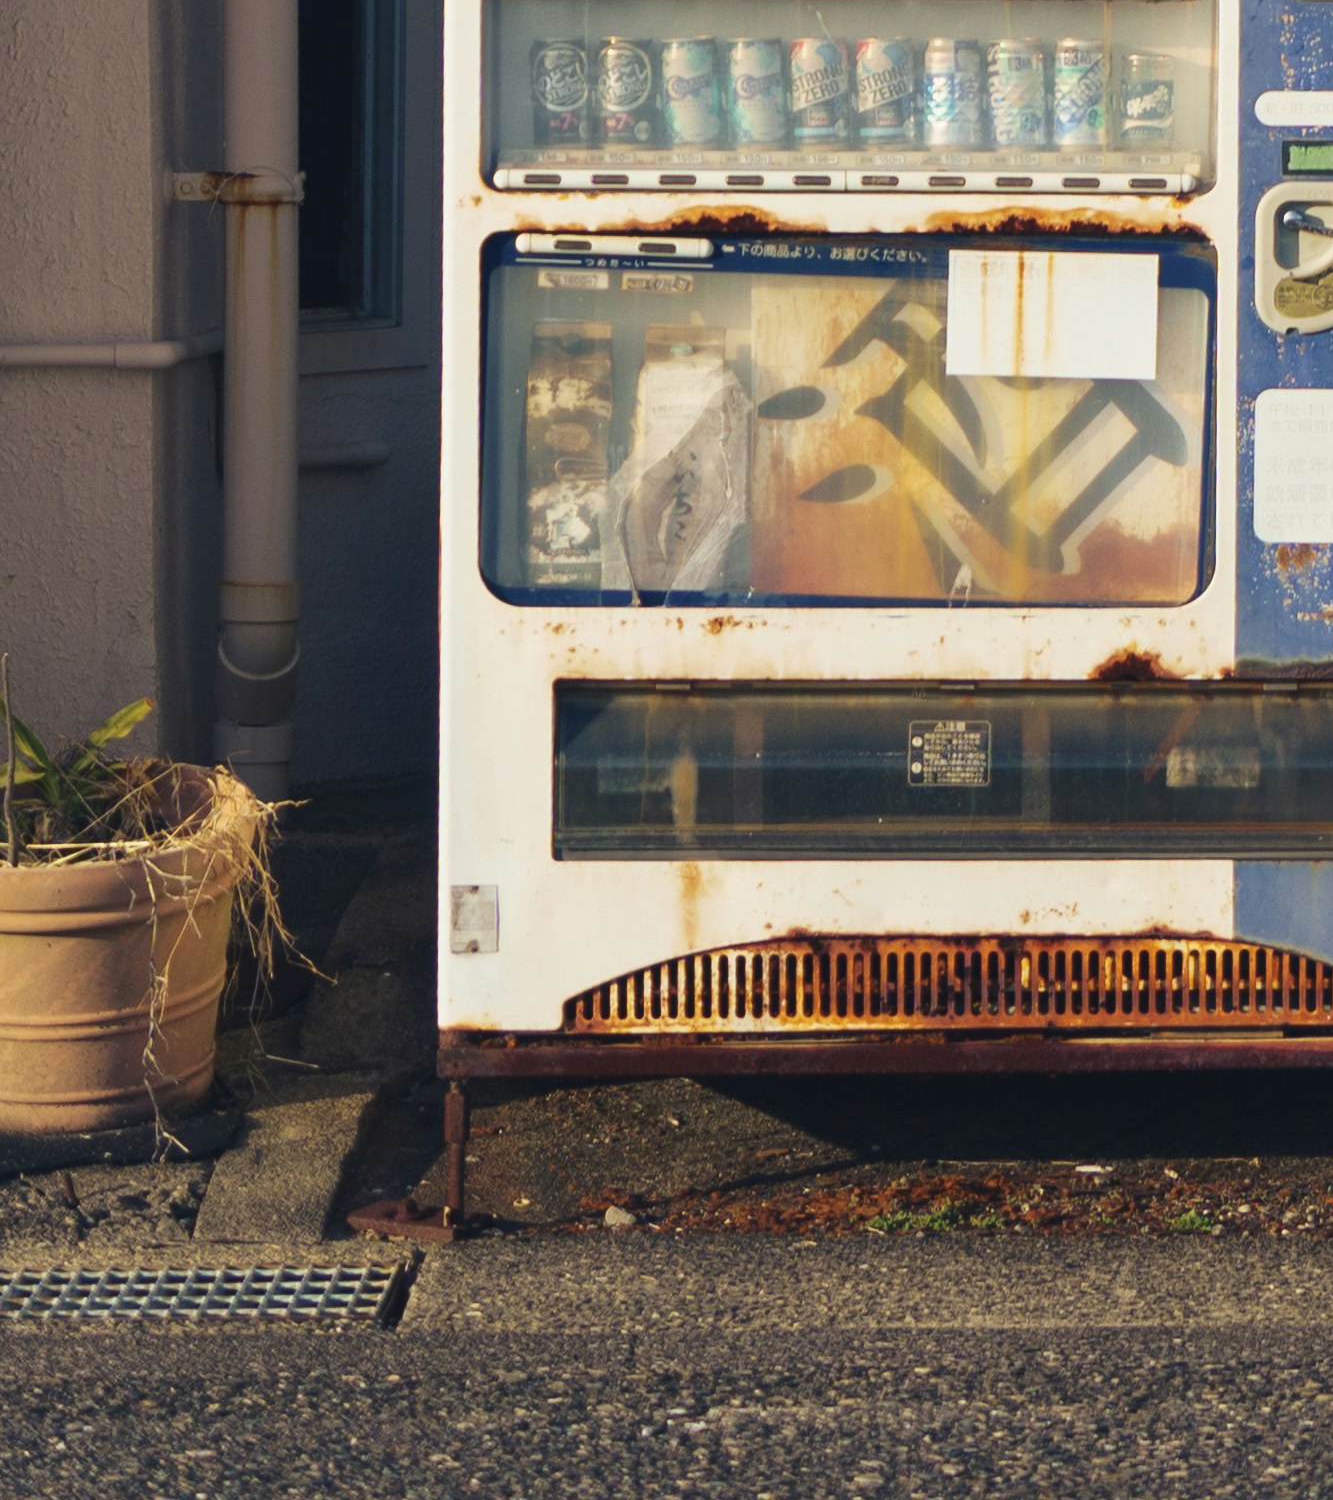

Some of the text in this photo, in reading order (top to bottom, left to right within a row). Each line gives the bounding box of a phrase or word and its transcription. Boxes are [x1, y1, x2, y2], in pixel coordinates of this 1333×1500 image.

[804, 80, 839, 104] ZERO
[871, 79, 908, 104] ZERO
[738, 242, 928, 263] 下の商品より、お選びください。
